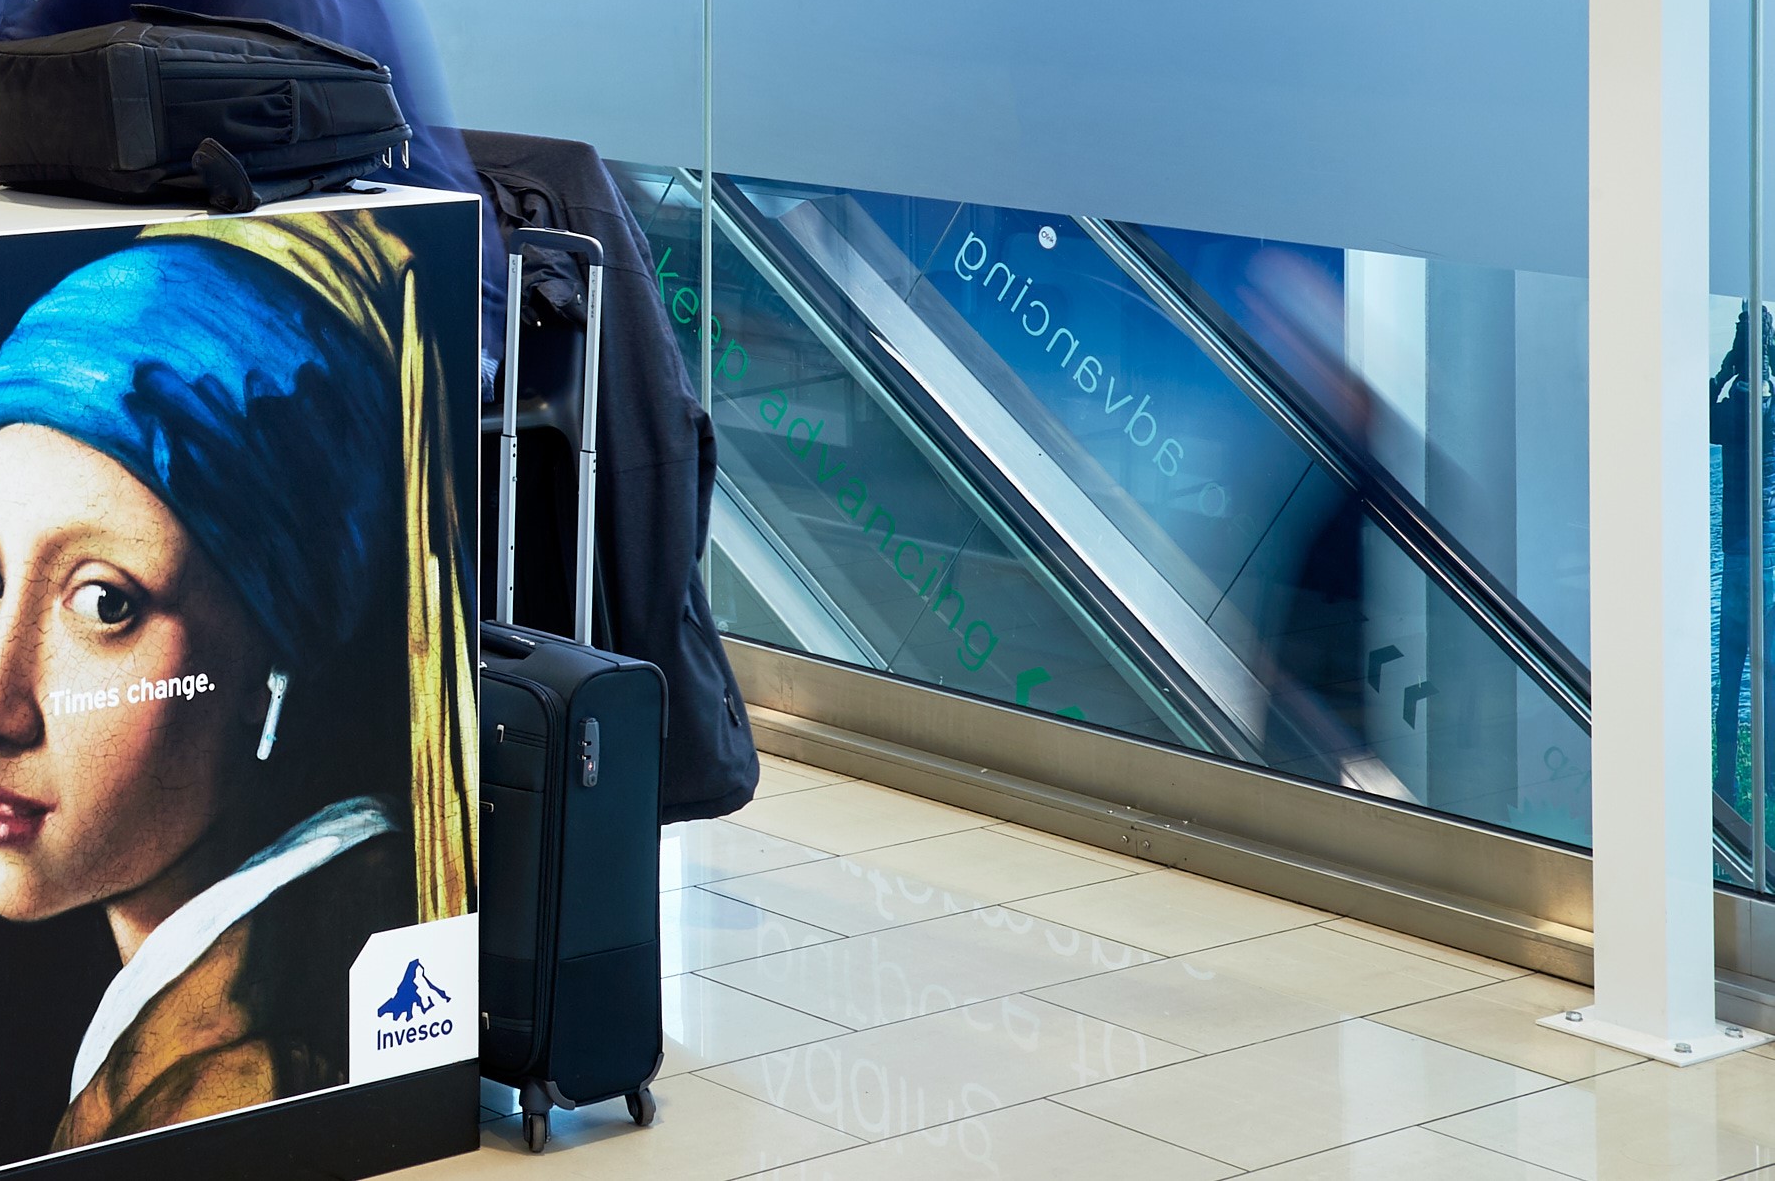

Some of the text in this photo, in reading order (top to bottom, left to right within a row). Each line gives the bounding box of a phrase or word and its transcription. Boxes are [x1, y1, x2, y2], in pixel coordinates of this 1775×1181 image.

[758, 388, 1000, 672] advancing
[49, 673, 216, 716] Times change.
[377, 1018, 453, 1051] Invesco
